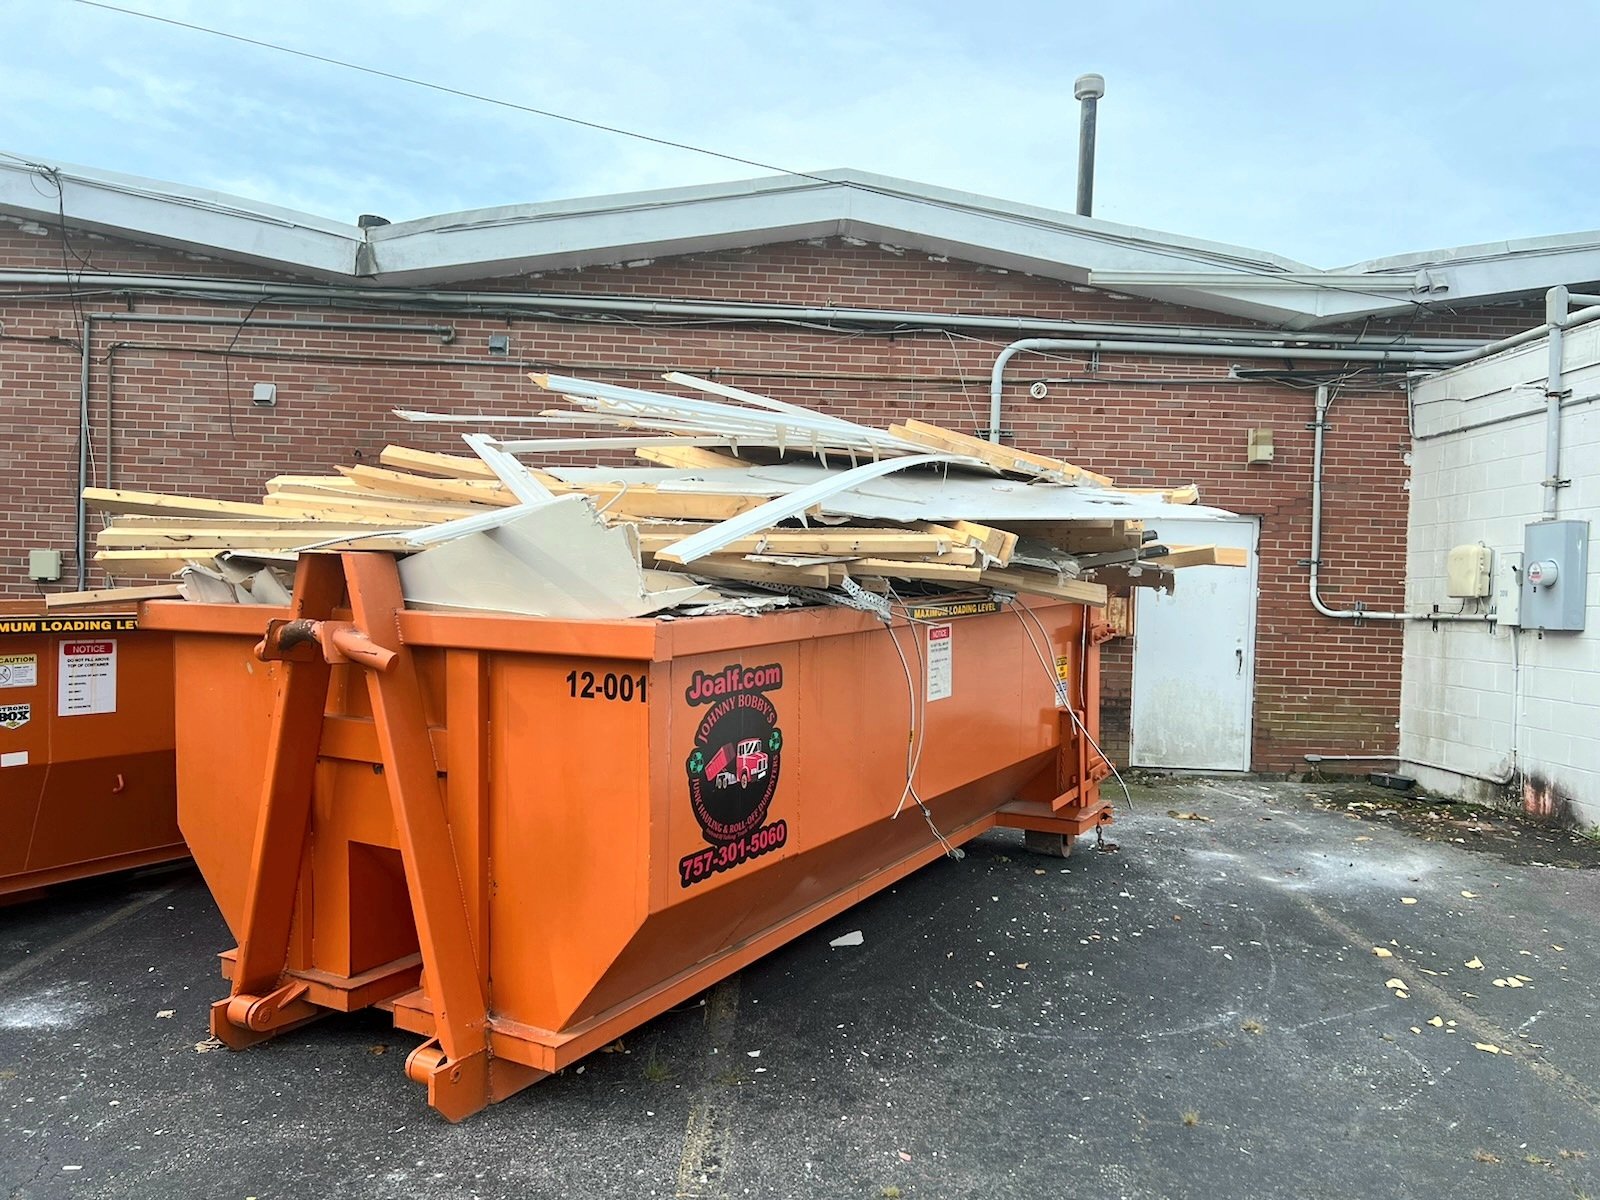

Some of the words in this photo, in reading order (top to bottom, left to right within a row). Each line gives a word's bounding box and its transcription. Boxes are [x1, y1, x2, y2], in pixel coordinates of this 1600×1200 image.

[948, 604, 977, 616] LOADING
[977, 602, 996, 612] LEVEL
[41, 621, 112, 631] LOADING
[932, 629, 947, 638] NOTICE
[72, 645, 105, 654] NOTICE
[566, 670, 647, 703] 12-001
[689, 667, 780, 700] Joalf.com
[0, 711, 30, 722] BOX
[698, 696, 736, 744] JOHNNY
[738, 694, 775, 724] BOBBY'S
[693, 778, 702, 806] JUNK
[698, 804, 722, 833] HAULING
[723, 824, 728, 834] &
[729, 808, 759, 833] ROLL-OFF
[758, 754, 779, 814] DUMPSTERS
[682, 823, 785, 881] 757-301-5060
